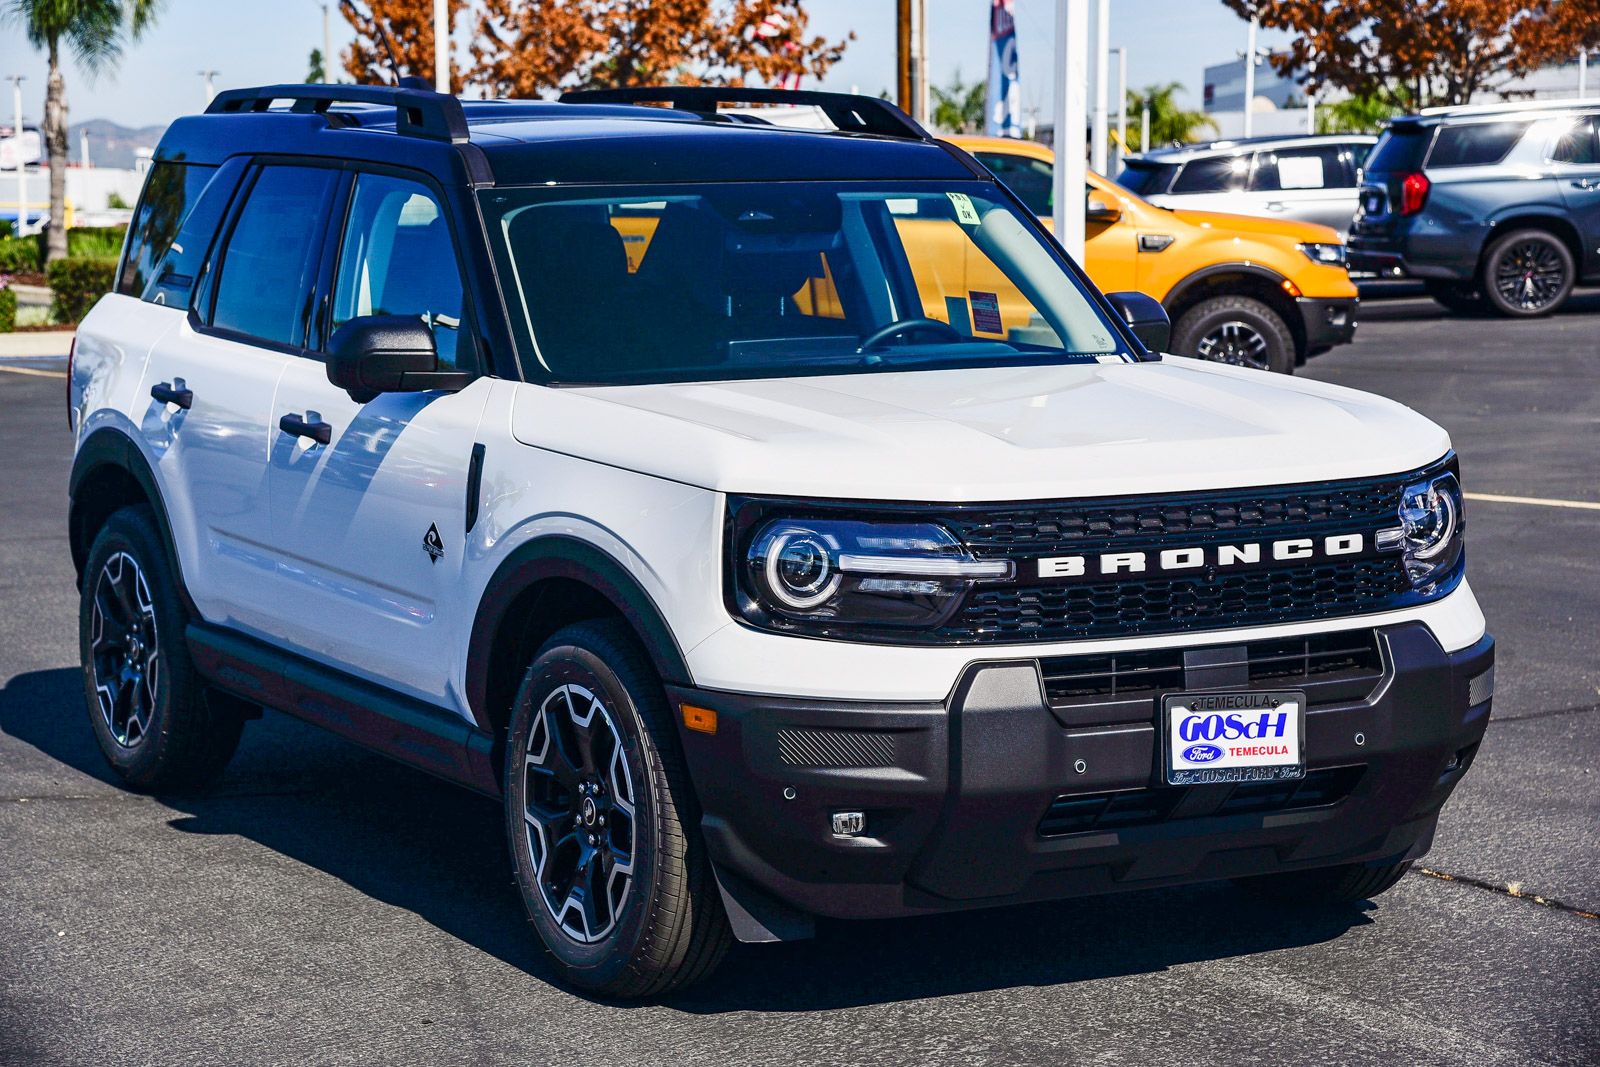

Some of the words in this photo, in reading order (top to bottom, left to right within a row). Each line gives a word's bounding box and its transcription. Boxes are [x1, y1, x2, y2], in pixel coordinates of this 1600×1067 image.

[961, 210, 973, 219] OK
[1037, 533, 1363, 578] BRONCO
[1199, 695, 1271, 709] TEMECULA
[1189, 746, 1215, 761] Ford
[1229, 745, 1289, 757] TEMECULA
